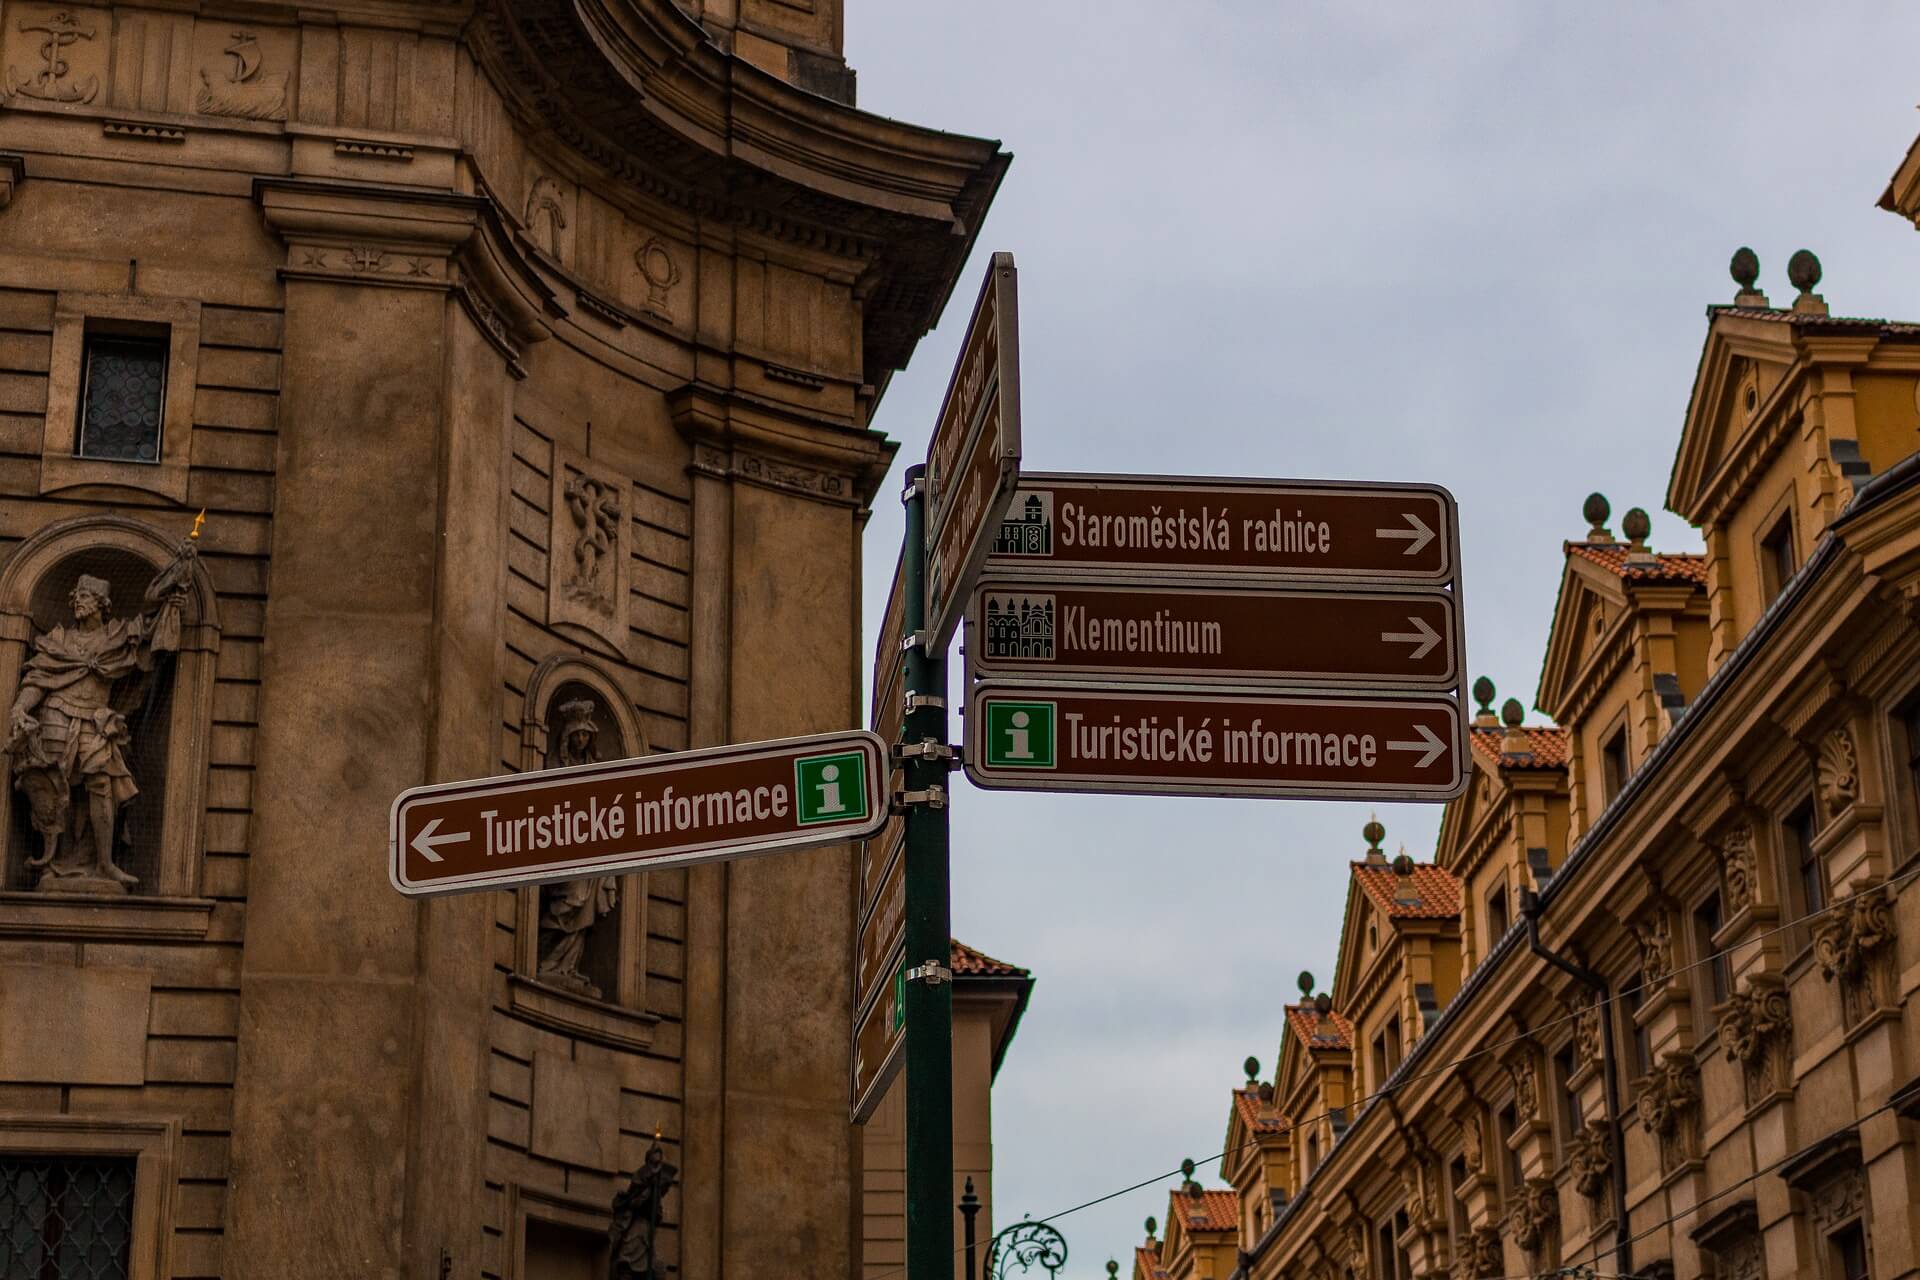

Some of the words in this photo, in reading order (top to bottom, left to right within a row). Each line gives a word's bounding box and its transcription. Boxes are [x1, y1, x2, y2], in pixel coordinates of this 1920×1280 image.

[1060, 501, 1230, 551] Staroměstská
[1242, 509, 1331, 554] radnice
[1063, 605, 1222, 655] Klementinum
[1065, 712, 1213, 763] Turistické
[1223, 718, 1377, 768] informace
[480, 793, 625, 857] Turistické
[635, 782, 788, 837] informace
